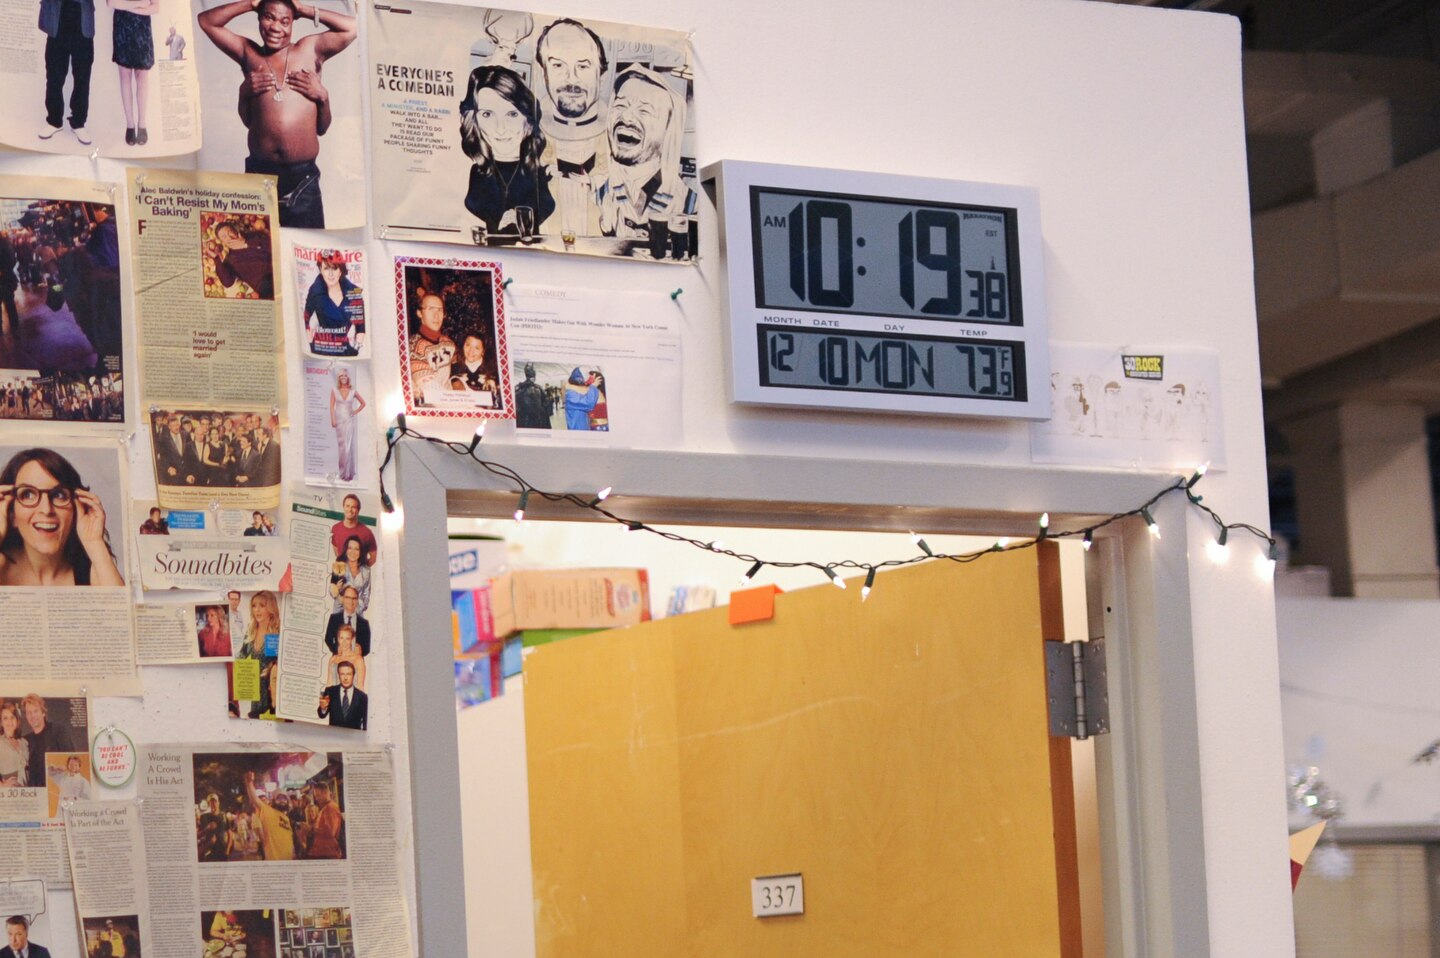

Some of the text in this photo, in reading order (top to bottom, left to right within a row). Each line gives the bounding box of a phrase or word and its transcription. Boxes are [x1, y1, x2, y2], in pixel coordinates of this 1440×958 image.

[376, 64, 454, 83] EVERYONE'S
[377, 78, 454, 97] A COMEDIAN
[390, 134, 415, 142] PACKAGE
[144, 196, 174, 205] Can't
[177, 197, 209, 208] Resist
[213, 199, 228, 211] My
[231, 200, 265, 211] Mom's
[152, 206, 192, 218] Baking'
[763, 216, 786, 228] AM
[788, 201, 962, 315] 10:19
[964, 270, 1007, 319] 38
[764, 315, 988, 337] MONTH DATE DAY TEMP
[770, 334, 794, 371] 12
[818, 337, 849, 386] 10
[855, 340, 934, 389] MON
[154, 553, 272, 576] Soundbites
[8, 789, 19, 798] 30
[20, 789, 38, 798] Rock
[763, 885, 796, 908] 337
